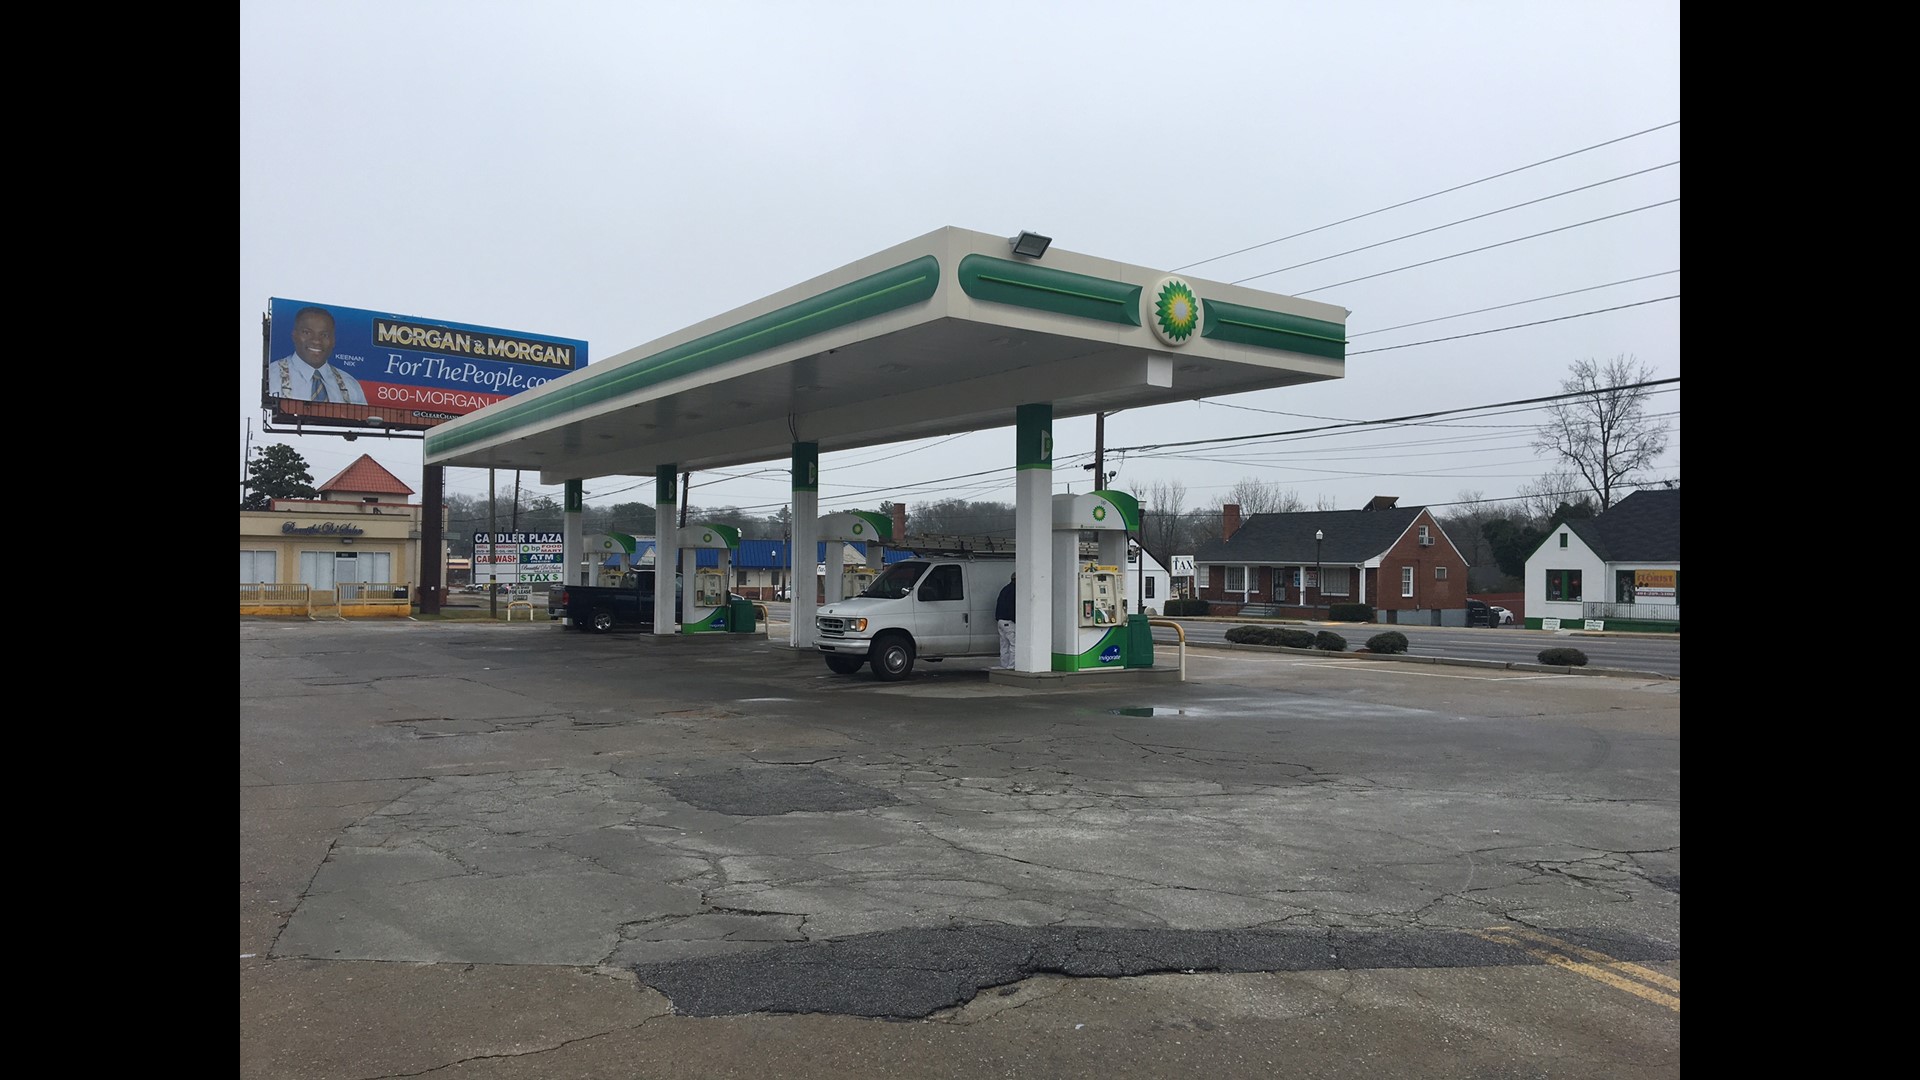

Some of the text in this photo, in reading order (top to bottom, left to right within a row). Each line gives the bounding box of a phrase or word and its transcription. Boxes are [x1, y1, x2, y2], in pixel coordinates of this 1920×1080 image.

[378, 322, 570, 366] MORGAN & MORGAN
[335, 353, 364, 362] KEENAN
[384, 353, 553, 392] ForThePeople.co
[475, 533, 563, 543] CADLER PLAZA
[1172, 560, 1193, 570] TAX
[528, 574, 550, 582] TAX
[1099, 654, 1121, 662] Invigorate
